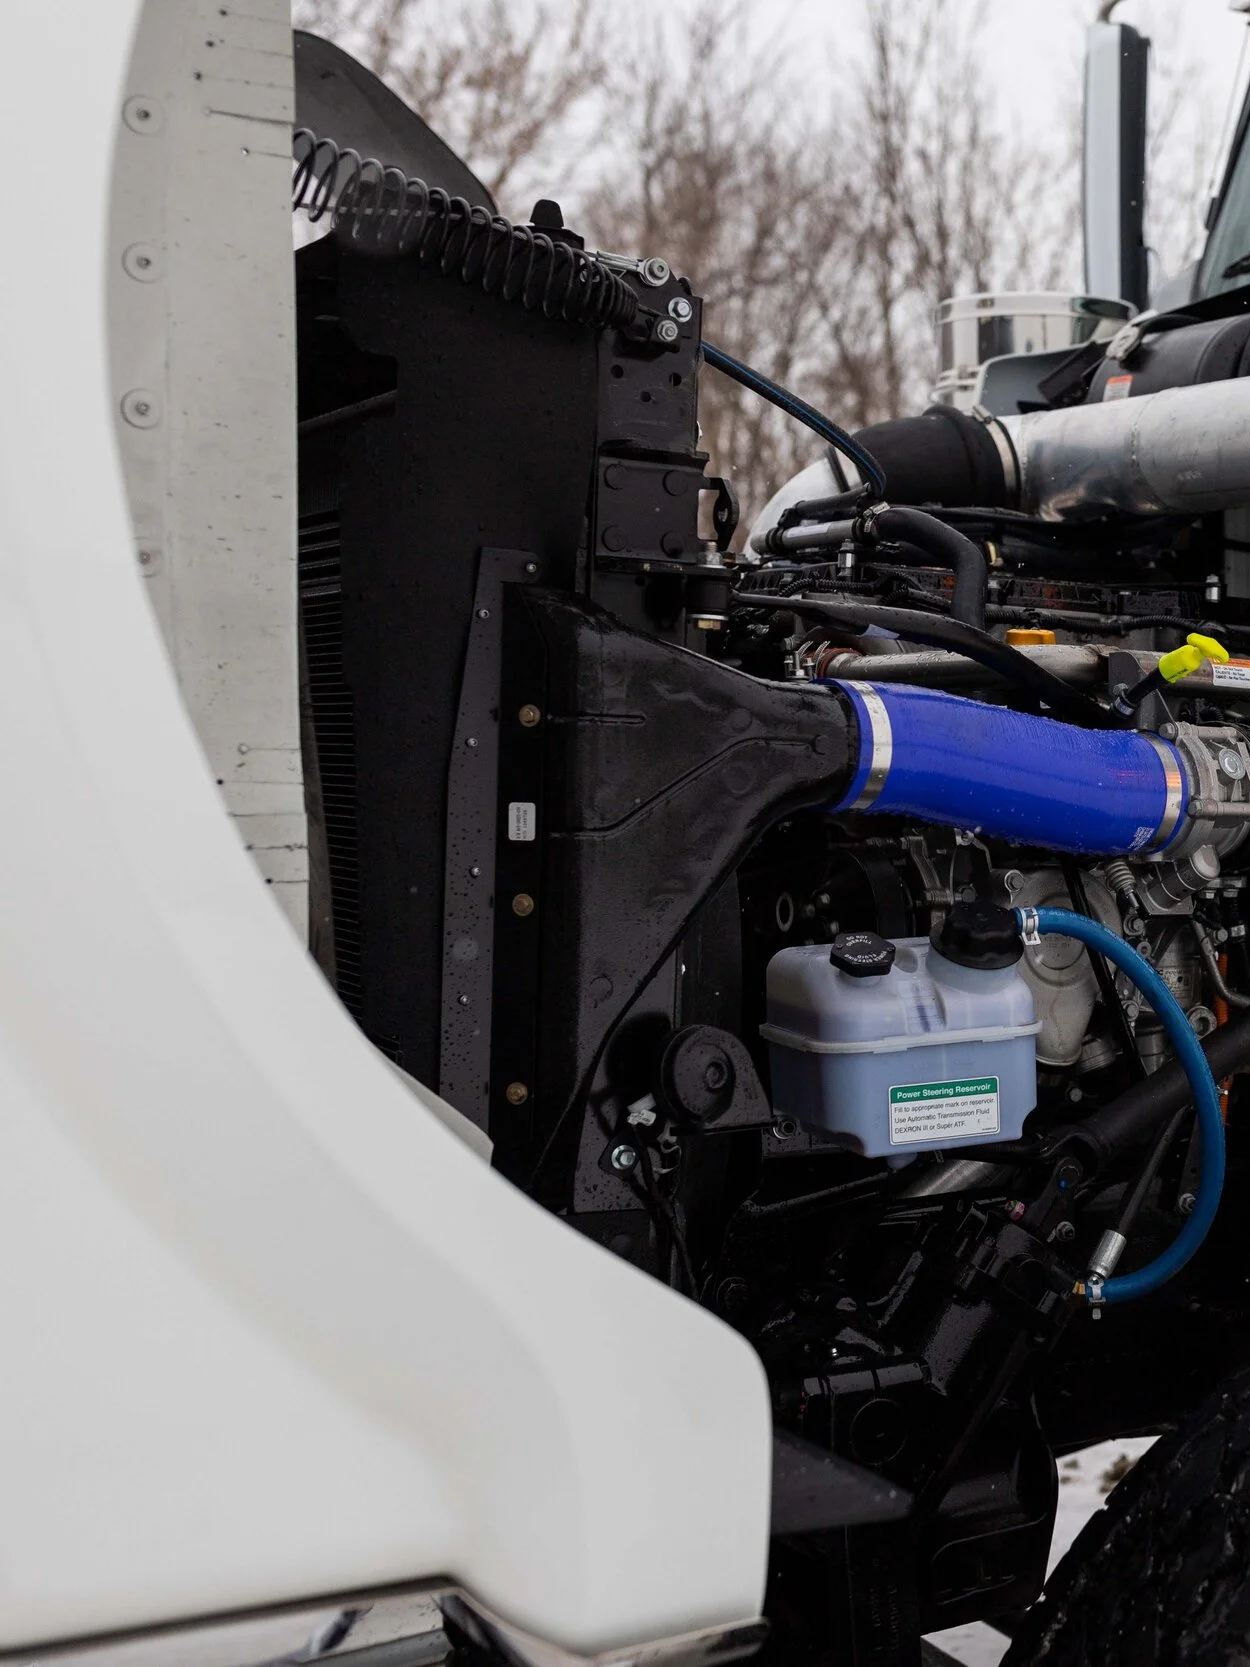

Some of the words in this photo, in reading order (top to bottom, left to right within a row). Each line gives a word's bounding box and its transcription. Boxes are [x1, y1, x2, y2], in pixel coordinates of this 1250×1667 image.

[844, 954, 873, 963] STEERING
[923, 1087, 953, 1097] Steering
[956, 1083, 991, 1093] Reservoir
[911, 1104, 943, 1112] appropriate
[938, 1111, 975, 1119] Transmission
[937, 1122, 953, 1130] Super
